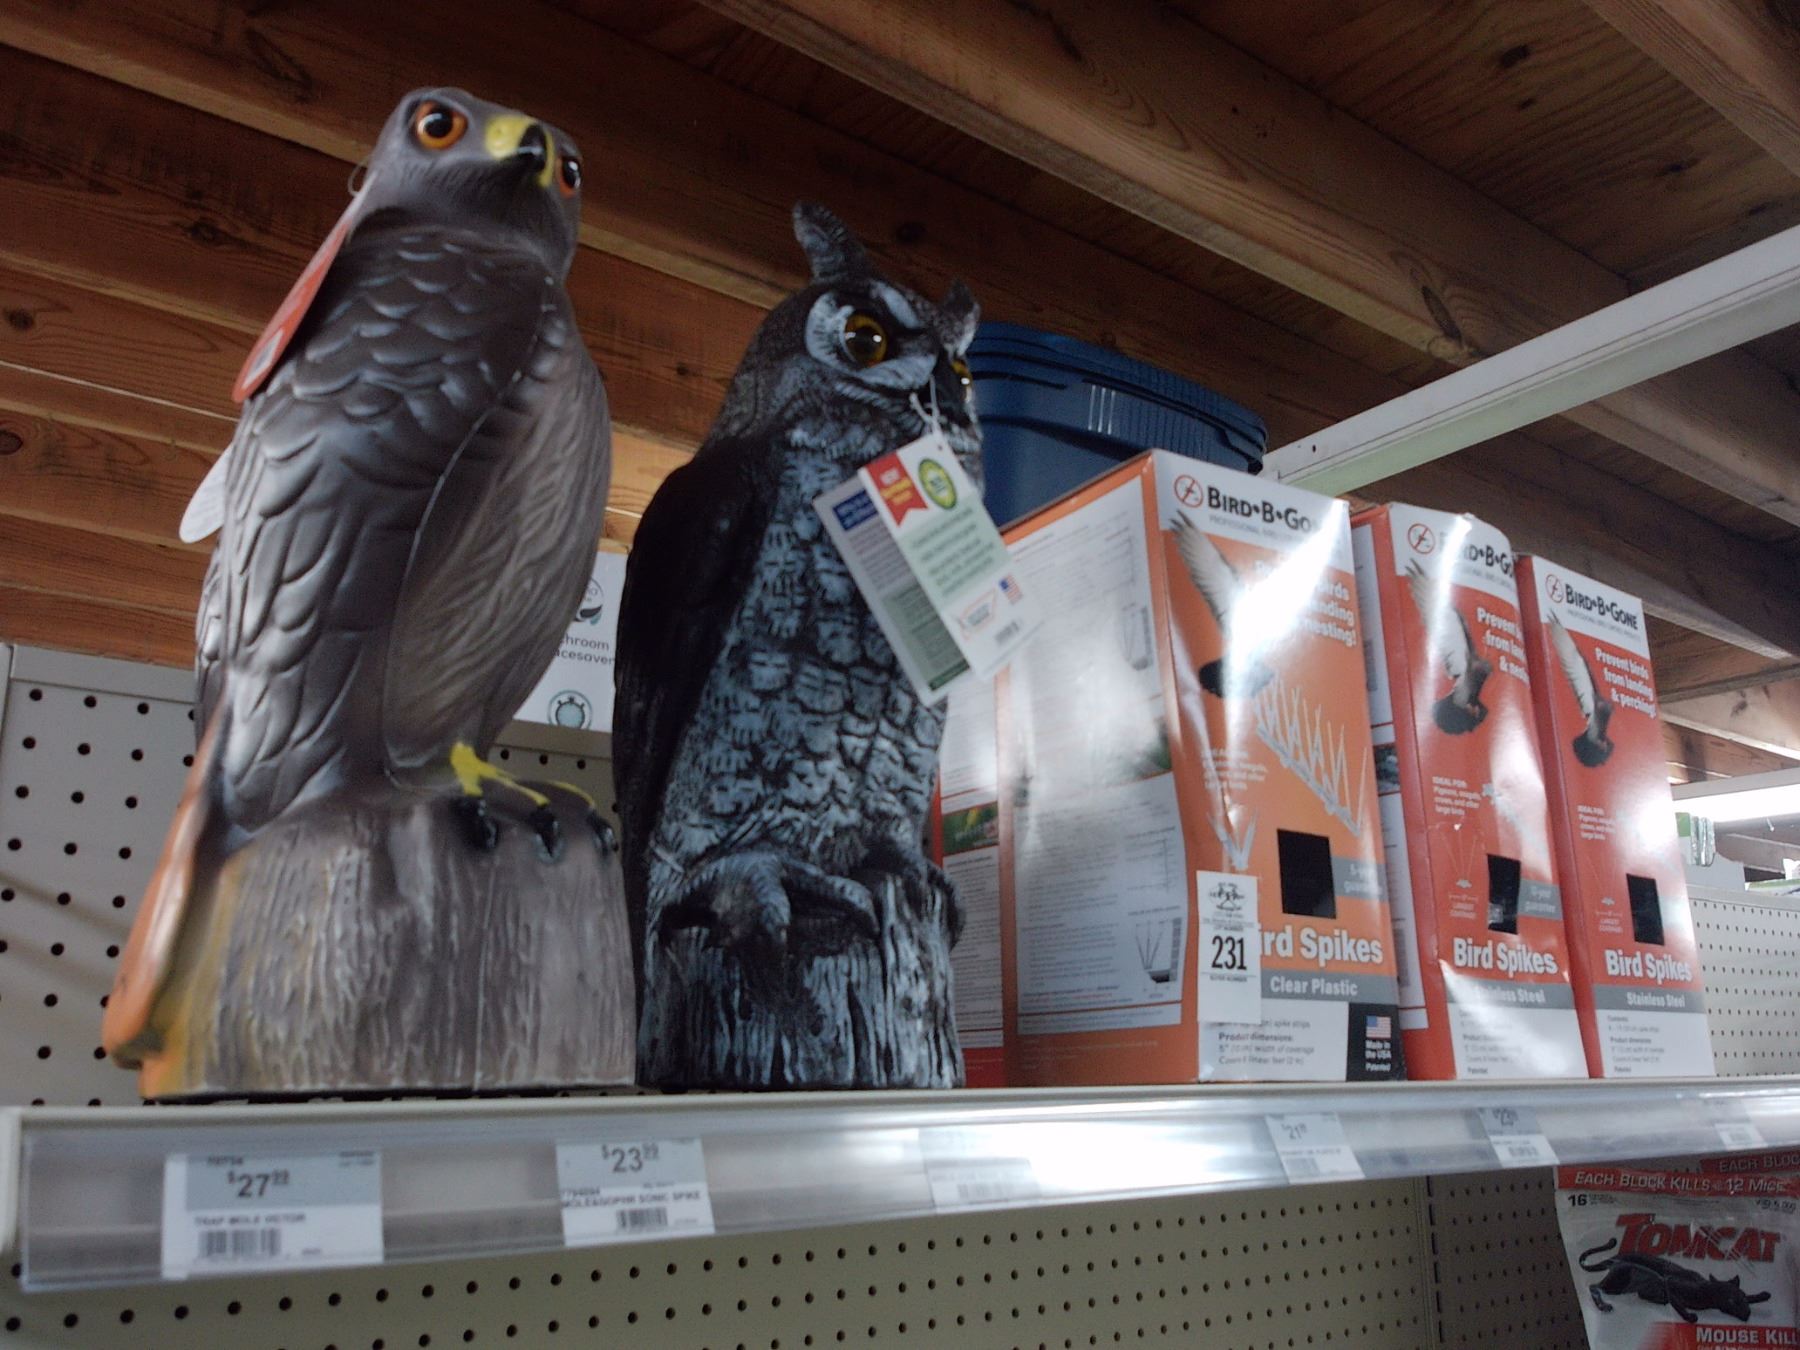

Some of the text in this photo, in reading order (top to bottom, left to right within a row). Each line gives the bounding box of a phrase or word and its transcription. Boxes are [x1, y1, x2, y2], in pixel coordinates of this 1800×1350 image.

[1211, 935, 1247, 970] 231
[1300, 926, 1383, 967] Spikes
[1453, 936, 1559, 979] Bird Spikes
[1605, 948, 1693, 985] Bird Spikes
[1270, 975, 1358, 996] Clear Plastic
[1517, 987, 1546, 1003] Steel
[1626, 991, 1686, 1008] Stainless Steel
[1719, 1158, 1759, 1173] EACH
[1574, 1171, 1614, 1186] EACH
[1619, 1173, 1665, 1190] BLOCK
[1670, 1177, 1711, 1192] KILLS
[1726, 1177, 1744, 1191] 12
[1749, 1178, 1787, 1193] MICE
[1568, 1194, 1588, 1207] 16
[1615, 1212, 1781, 1263] TOMCAT
[1696, 1326, 1759, 1344] MOUSE
